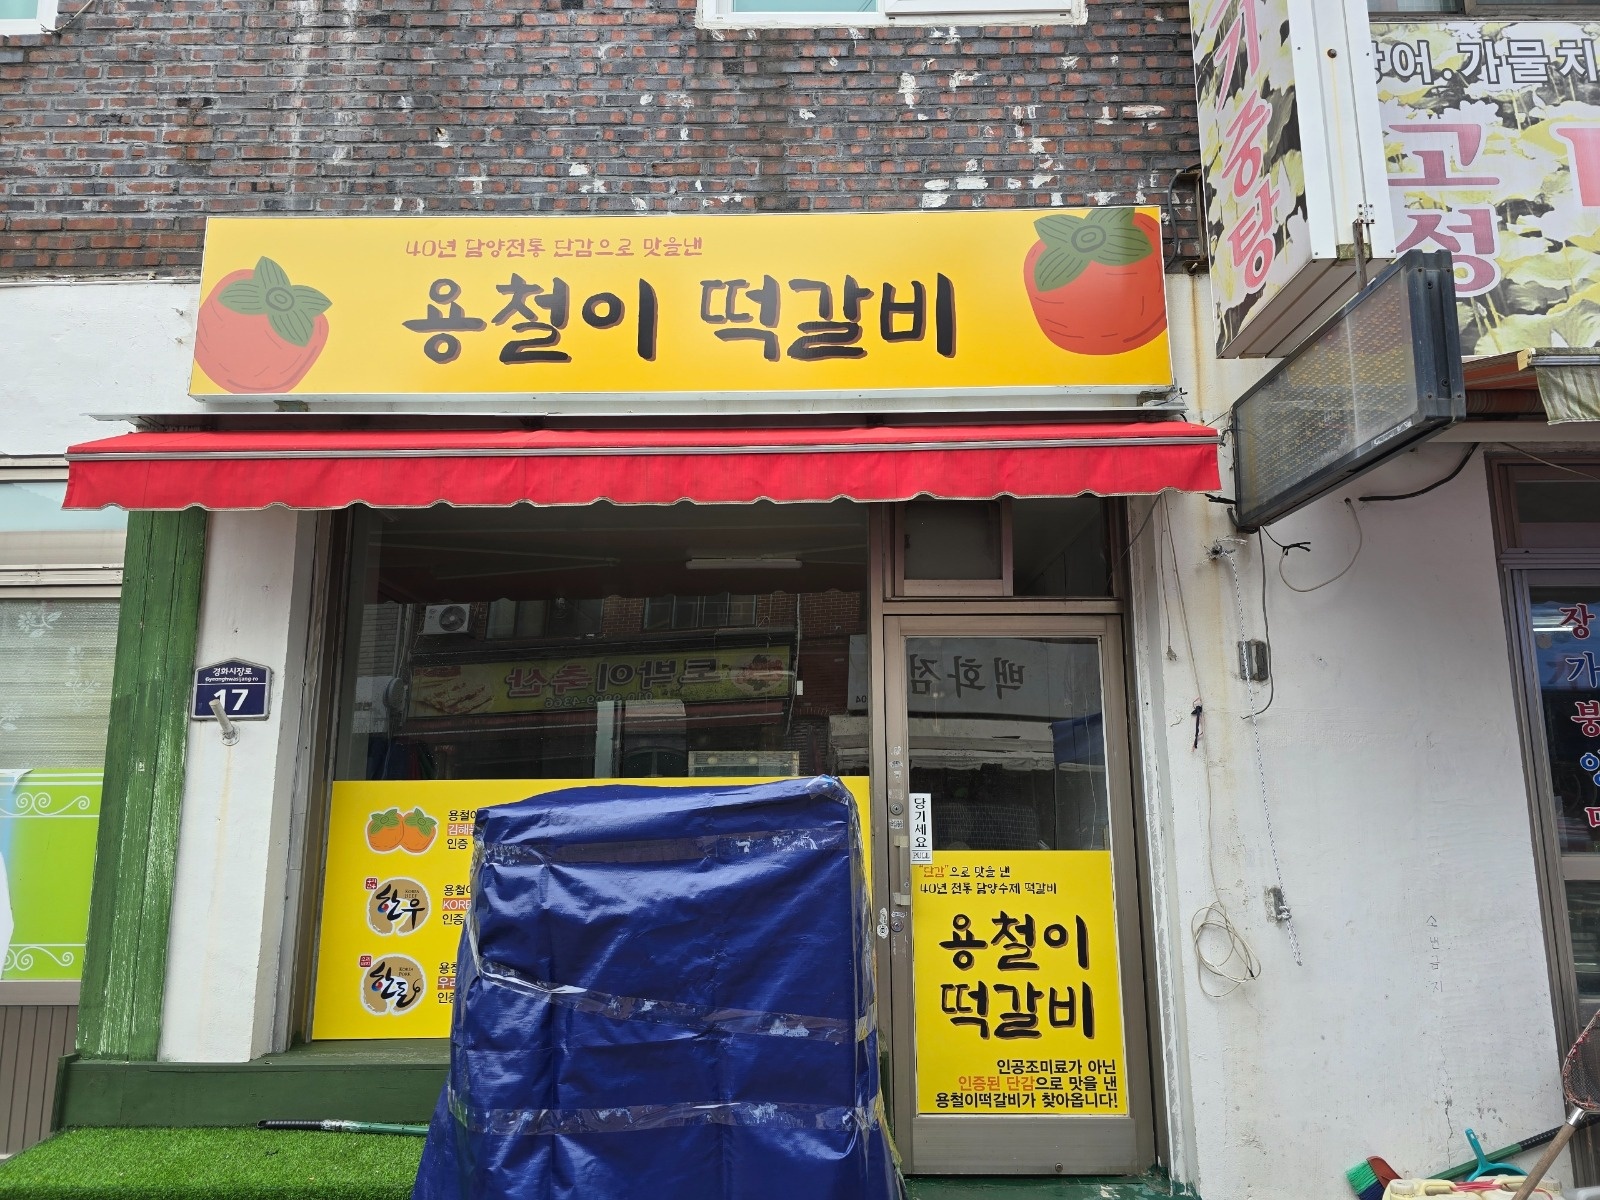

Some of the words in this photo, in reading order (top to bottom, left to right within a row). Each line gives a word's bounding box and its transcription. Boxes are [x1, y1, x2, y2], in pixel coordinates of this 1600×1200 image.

[405, 239, 457, 258] 40년
[465, 238, 546, 258] 담양전통
[554, 238, 635, 258] 단감으로
[643, 236, 703, 257] 맛을낸
[401, 272, 658, 364] 용철이
[699, 272, 956, 362] 떡갈비
[213, 667, 253, 676] 경화시장로
[213, 689, 249, 711] 17
[914, 797, 928, 848] 당기세요
[447, 838, 468, 850] 인증
[974, 866, 996, 878] 맛을
[999, 865, 1011, 878] 낸
[920, 883, 947, 895] 40년
[951, 882, 972, 895] 전통
[976, 882, 1021, 895] 담양수제
[1024, 882, 1057, 895] 떡갈비
[442, 913, 464, 925] 인증
[939, 910, 1090, 971] 용철이
[940, 981, 1094, 1039] 떡갈비
[996, 1059, 1083, 1075] 인공조미료가
[1088, 1059, 1116, 1075] 아닌
[958, 1075, 1001, 1092] 인증된
[1006, 1076, 1063, 1092] 단감으로
[1069, 1076, 1097, 1092] 맛을
[1103, 1075, 1118, 1092] 낸
[935, 1092, 1036, 1108] 용철이떡갈비가
[1041, 1092, 1118, 1108] 찾아옵니다!
